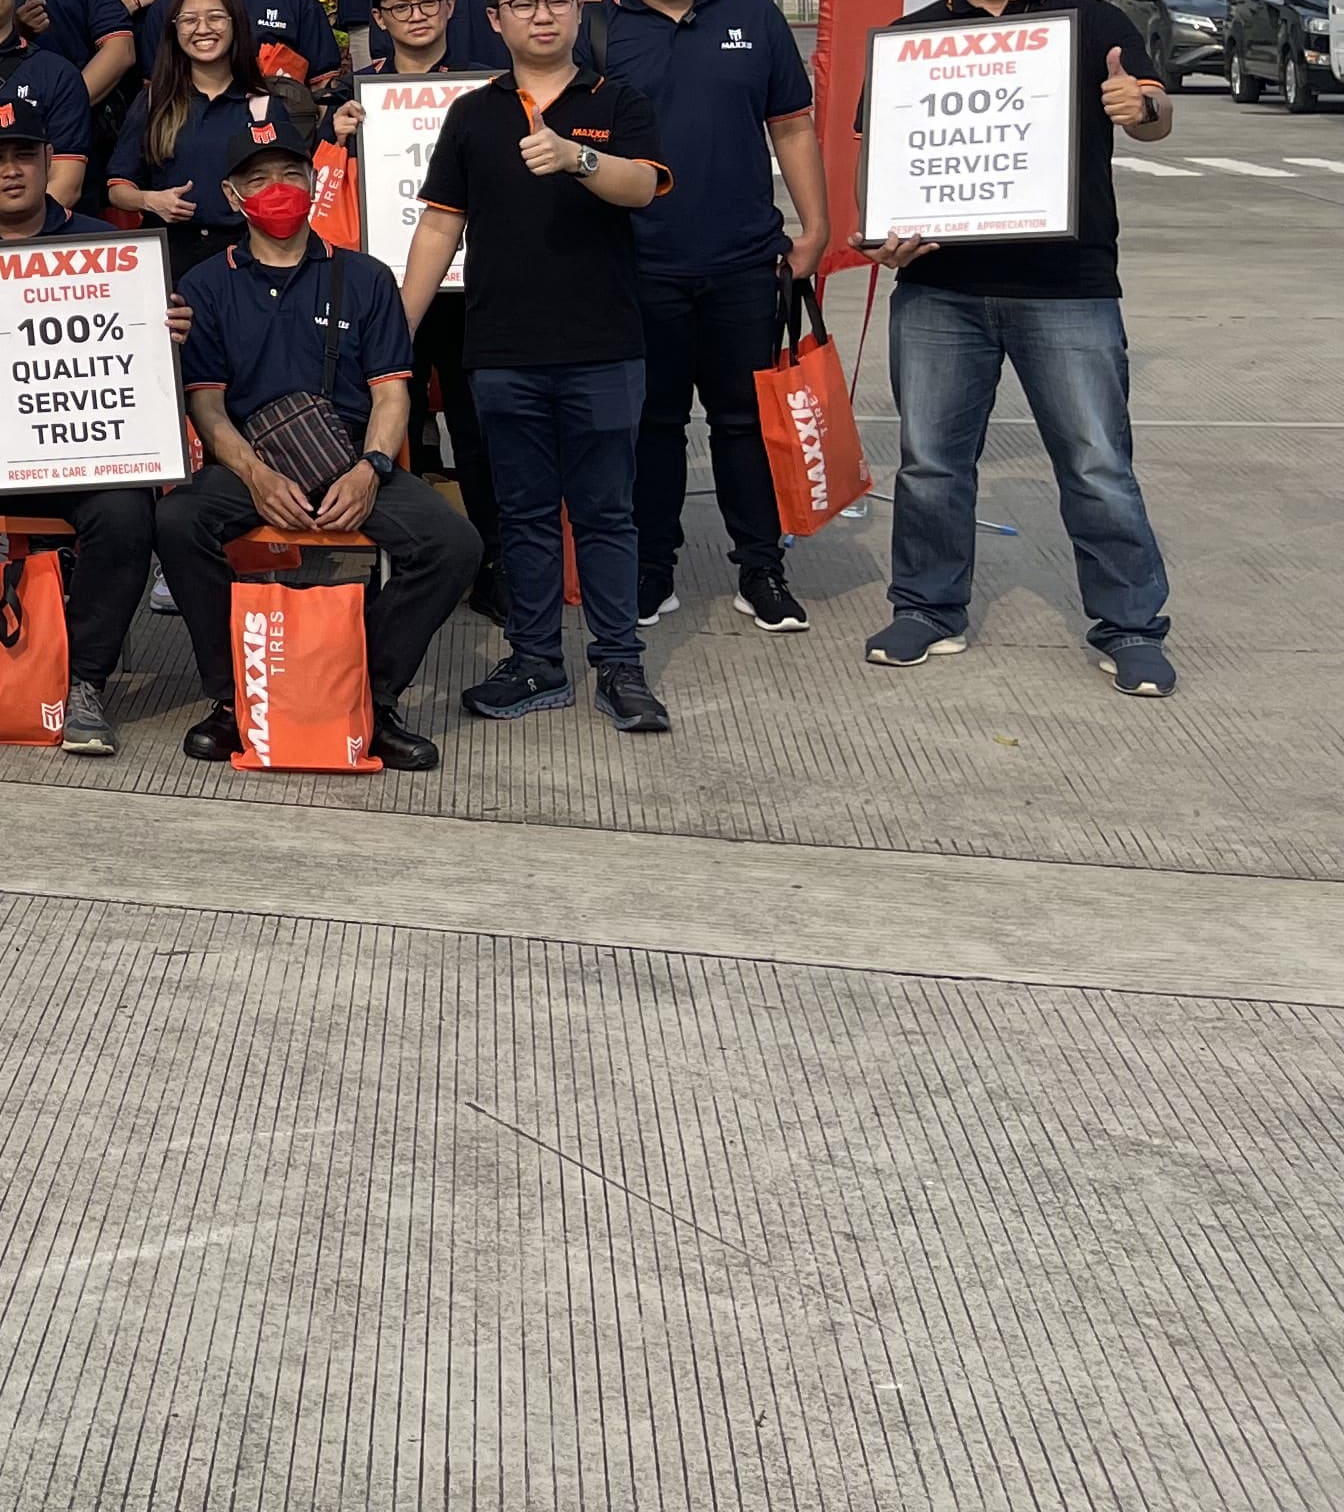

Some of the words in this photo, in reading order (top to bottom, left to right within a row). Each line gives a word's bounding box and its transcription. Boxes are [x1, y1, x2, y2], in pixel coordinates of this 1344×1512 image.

[897, 28, 1050, 63] MAXXIS
[929, 61, 1017, 80] CULTURE
[919, 86, 1025, 118] 100%
[908, 122, 1032, 150] QUALITY
[909, 152, 1029, 177] SERVICE
[317, 167, 345, 218] TIRES
[920, 181, 1015, 204] TRUST
[445, 273, 462, 282] ARE
[23, 283, 111, 303] CULTURE
[17, 312, 124, 346] 100%
[12, 354, 134, 384] QUALITY
[17, 387, 136, 414] SERVICE
[31, 419, 125, 445] TRUST
[787, 390, 828, 511] MAXXIS
[8, 468, 49, 480] RESPECT
[62, 465, 87, 478] CARE
[94, 462, 162, 476] APPRECIATION
[270, 611, 285, 676] TIRES
[243, 611, 270, 767] MAXXIS
